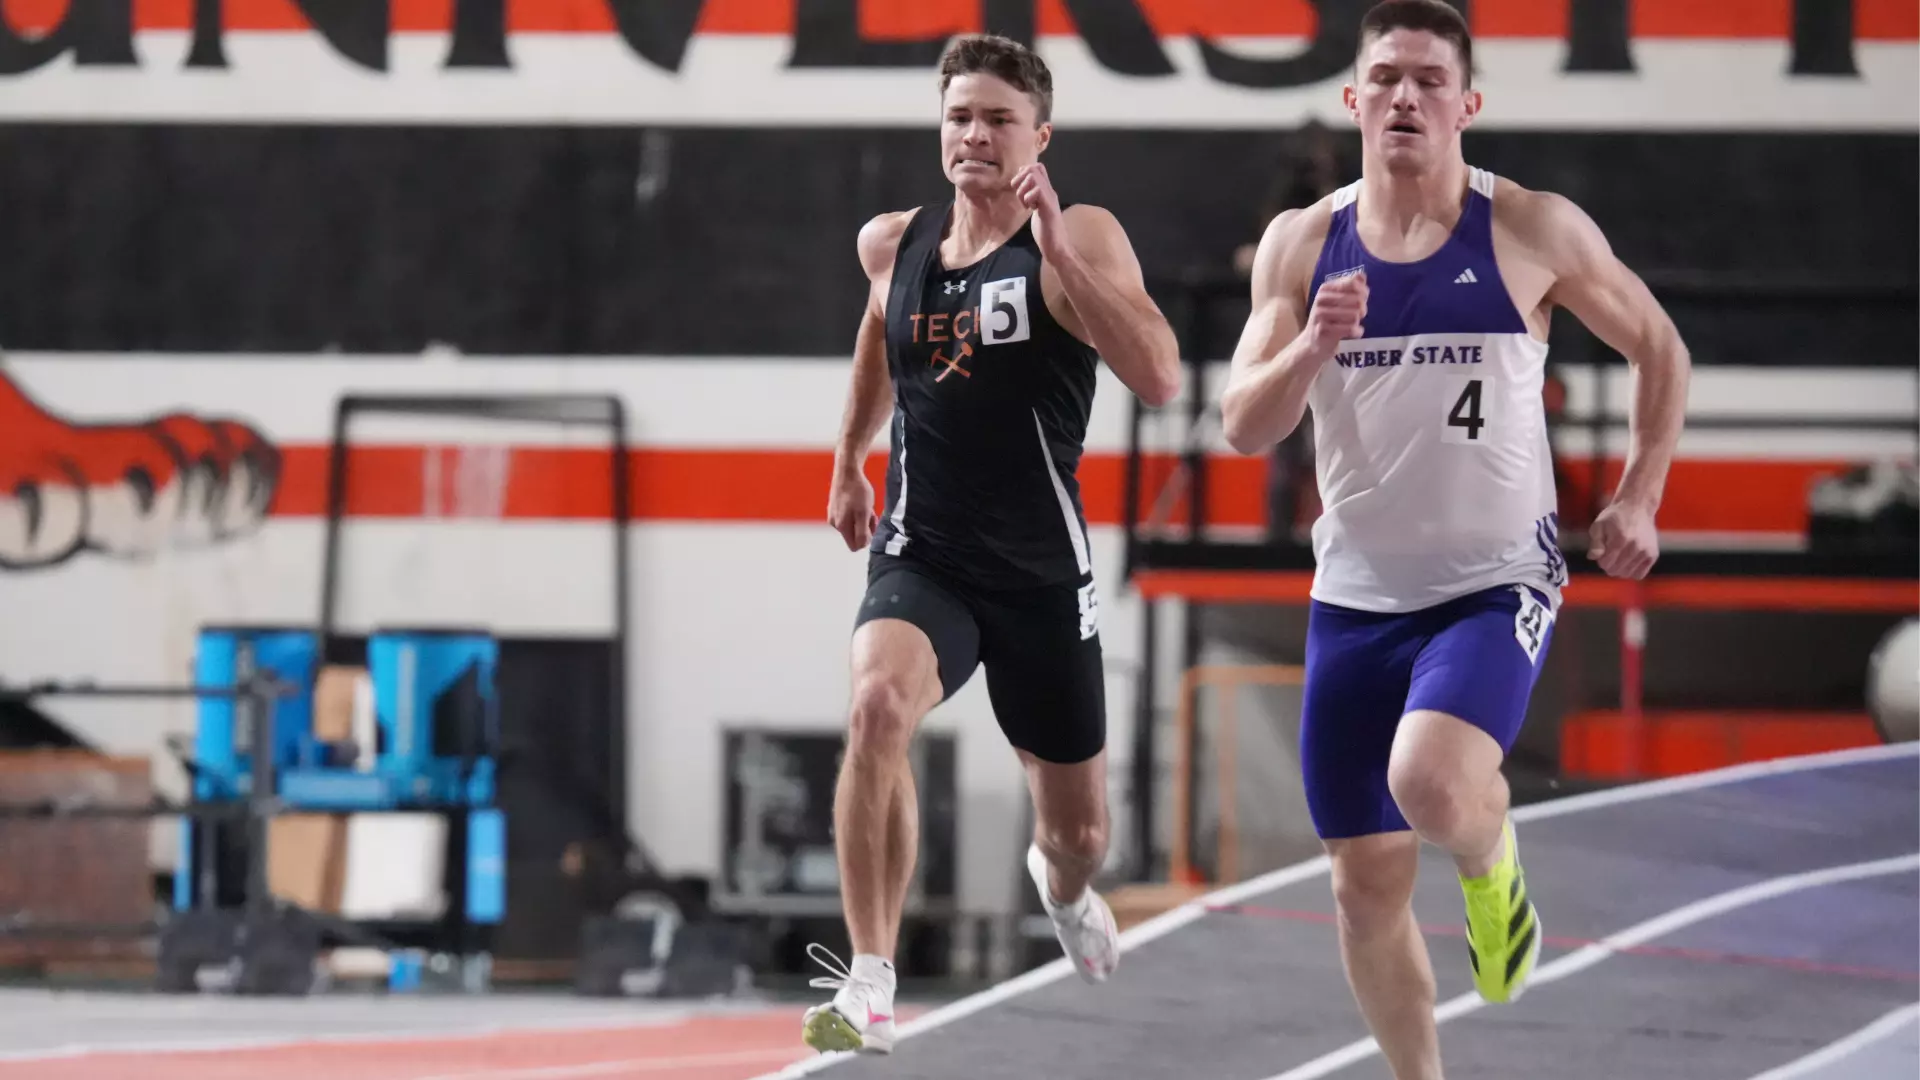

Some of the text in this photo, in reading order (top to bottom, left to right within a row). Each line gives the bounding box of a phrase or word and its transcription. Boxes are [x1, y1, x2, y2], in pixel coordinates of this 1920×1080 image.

[991, 281, 1018, 340] 5
[1335, 345, 1483, 369] WEBER STATE
[1447, 379, 1485, 440] 4
[1519, 603, 1544, 653] 4
